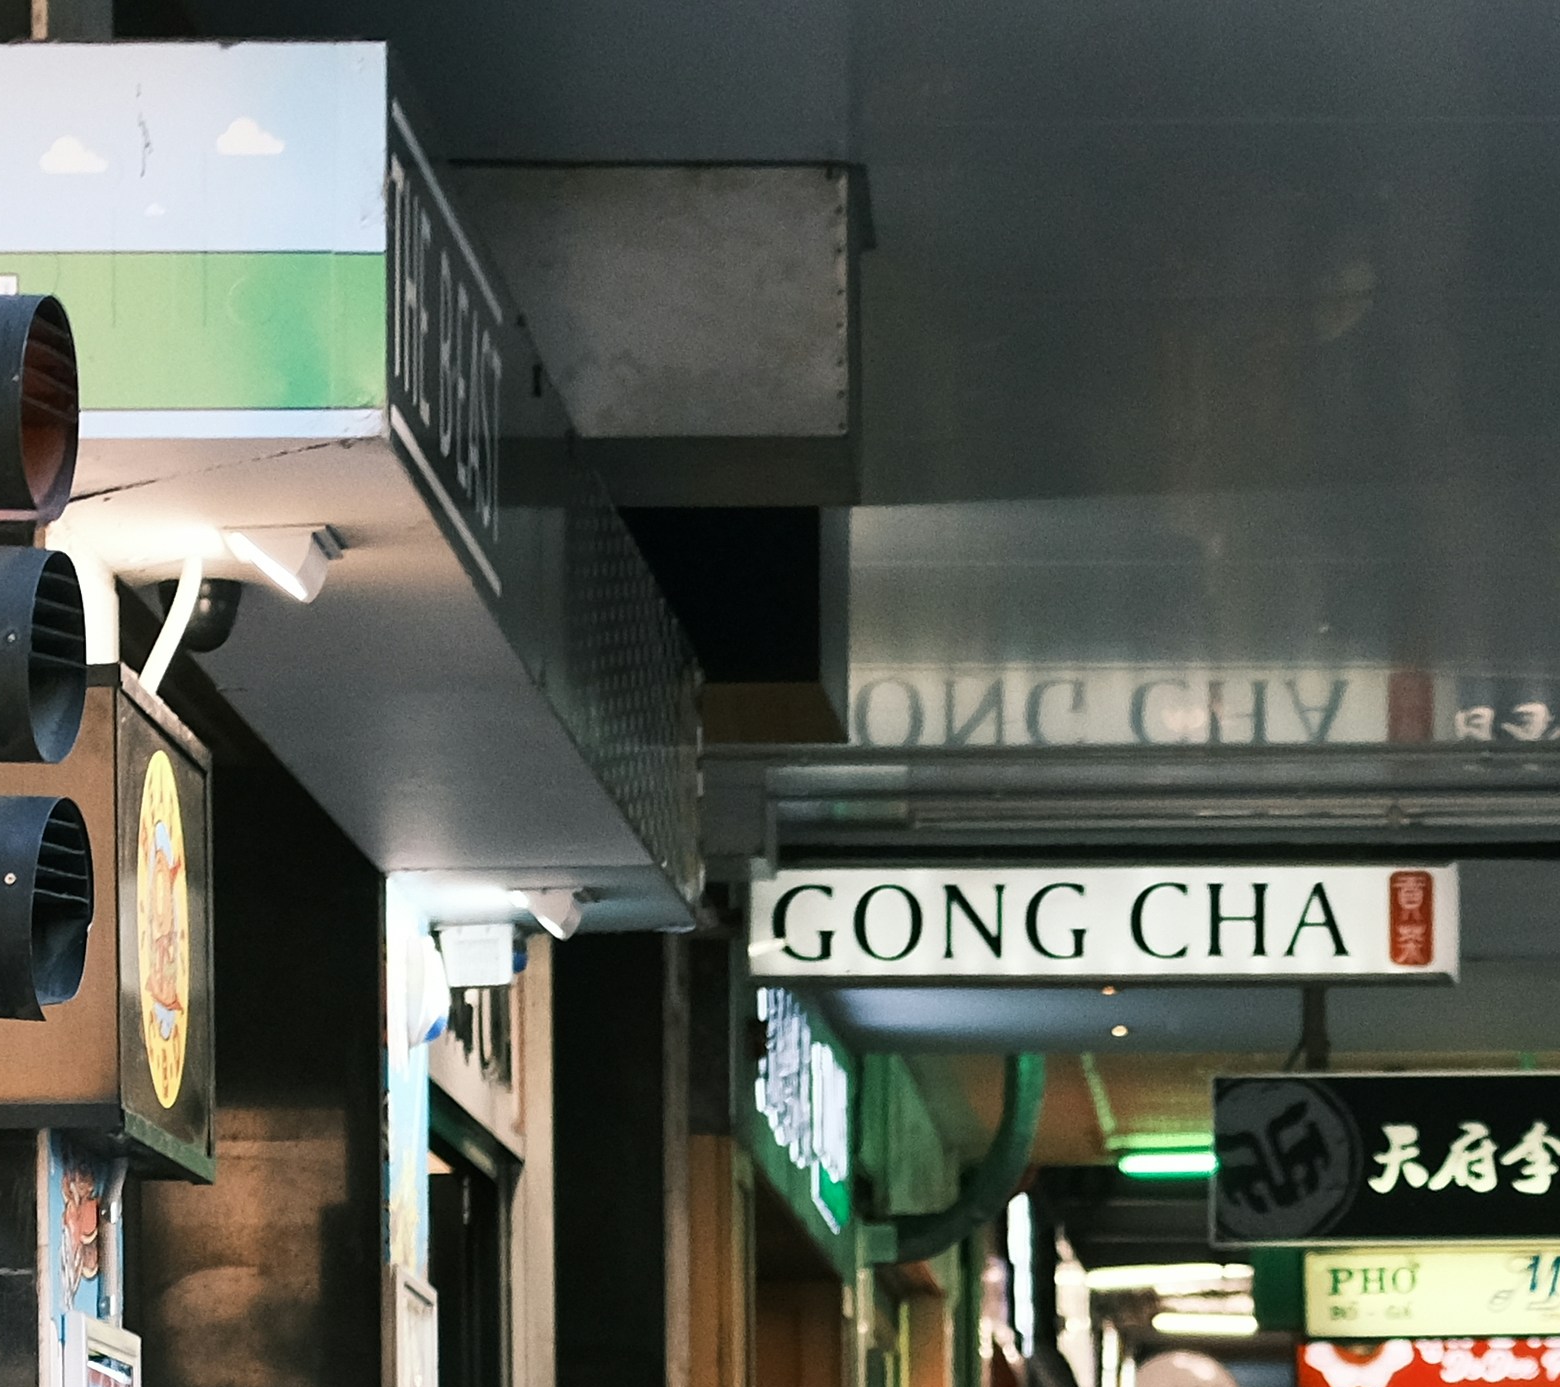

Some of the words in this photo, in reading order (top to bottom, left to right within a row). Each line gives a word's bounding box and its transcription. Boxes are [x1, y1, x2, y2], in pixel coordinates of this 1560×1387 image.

[390, 152, 432, 430] THE
[440, 246, 503, 545] BEAST
[770, 882, 1088, 963] GONG
[1130, 879, 1352, 959] CHA
